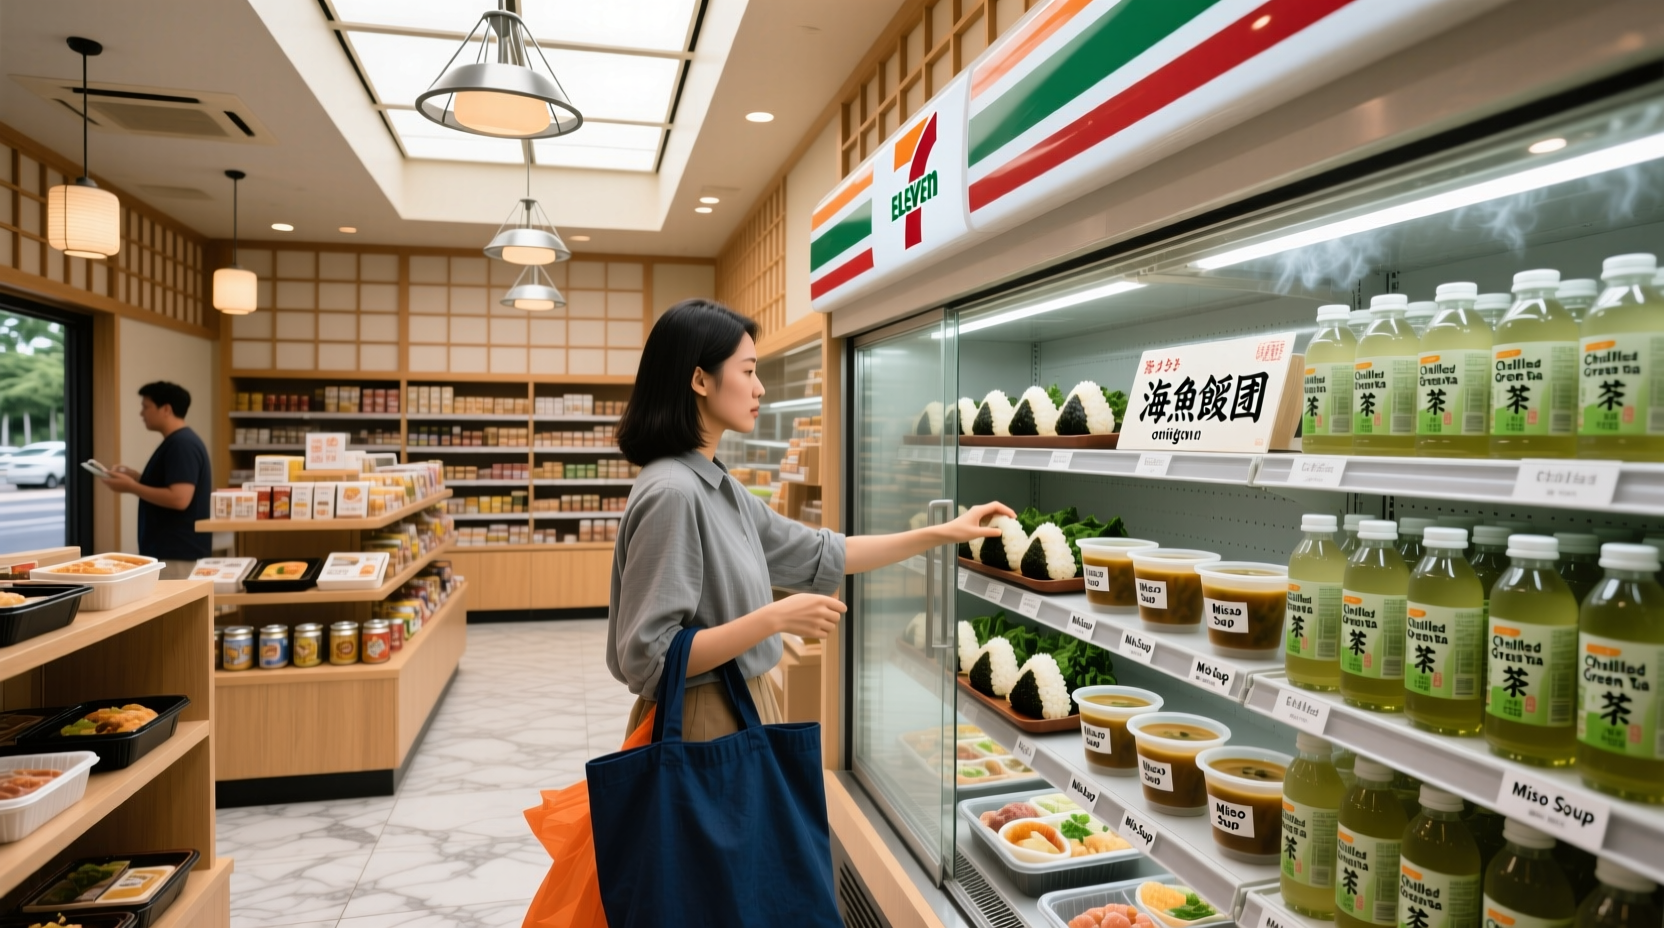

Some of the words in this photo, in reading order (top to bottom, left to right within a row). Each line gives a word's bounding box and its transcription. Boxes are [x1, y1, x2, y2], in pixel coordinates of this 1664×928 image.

[1360, 392, 1376, 417] 茶
[1426, 388, 1447, 415] 茶
[1506, 384, 1531, 415] 茶
[1597, 379, 1626, 411] 茶
[1291, 615, 1305, 638] 茶
[1349, 629, 1367, 656] 茶
[1414, 644, 1436, 674] 茶
[1503, 666, 1529, 698] 茶
[1600, 691, 1632, 726] 茶
[1512, 781, 1548, 806] Miso
[1553, 796, 1595, 827] Soup
[1284, 834, 1298, 861] 茶
[1342, 866, 1359, 895] 茶
